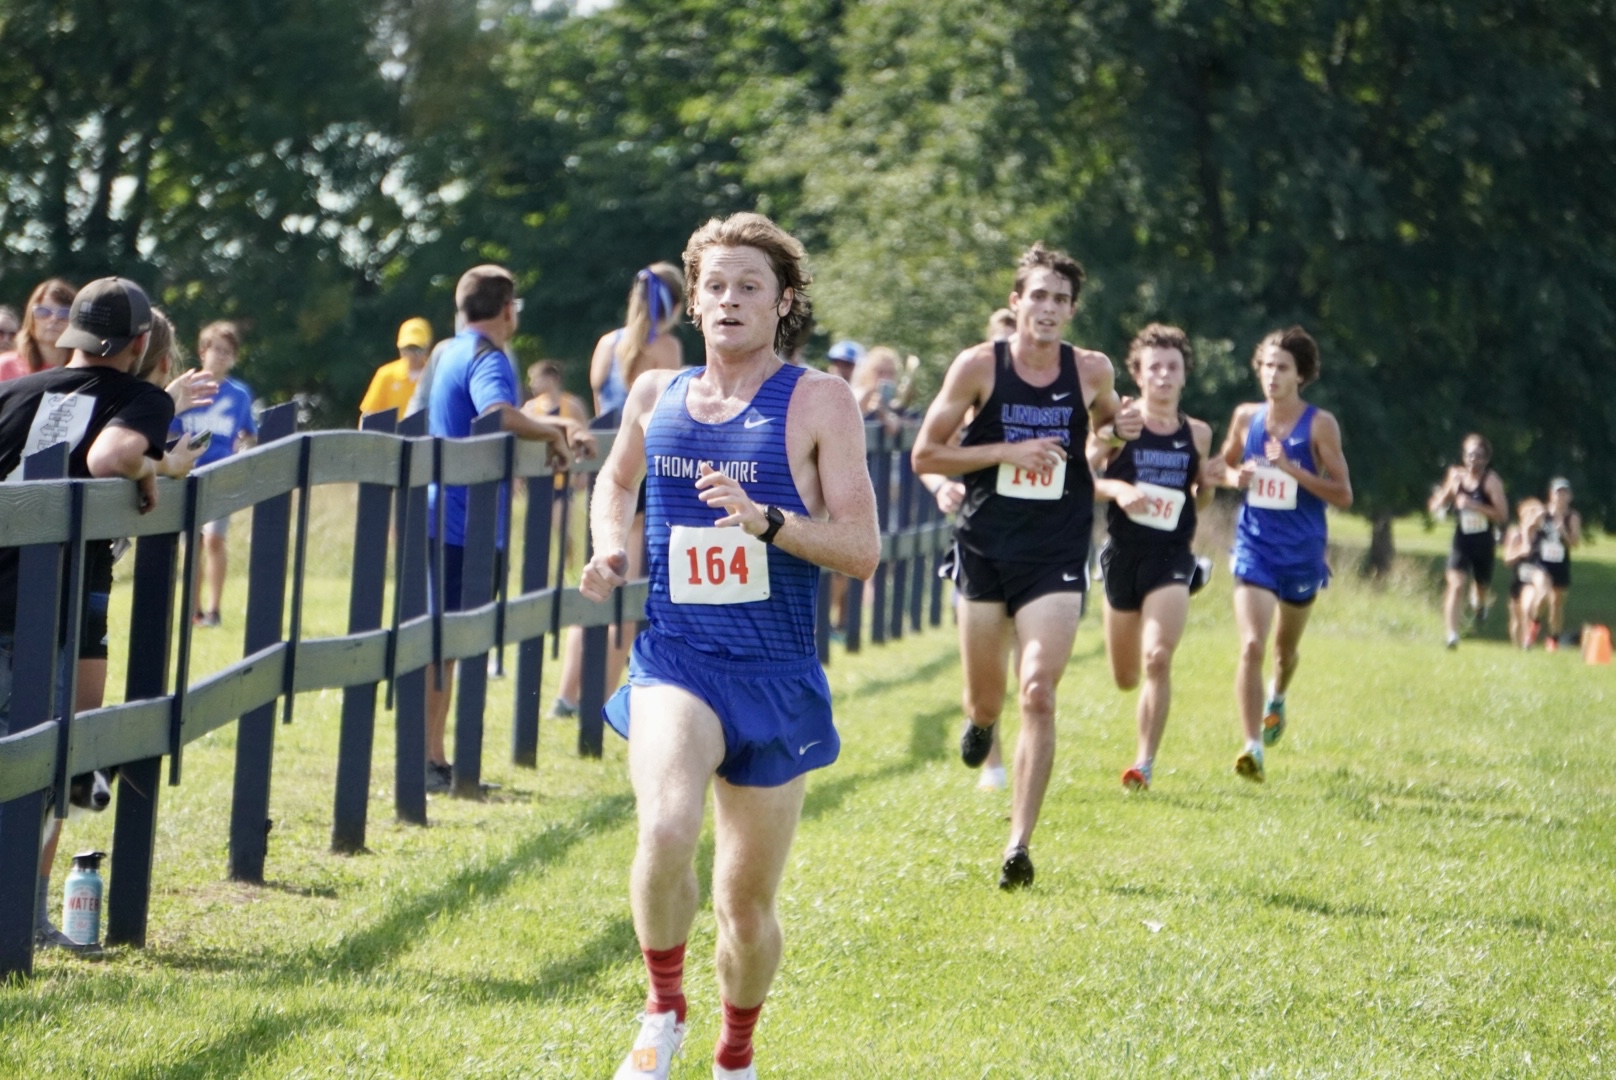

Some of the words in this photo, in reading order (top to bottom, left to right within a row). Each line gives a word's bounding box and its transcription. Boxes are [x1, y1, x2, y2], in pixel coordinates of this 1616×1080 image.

[1001, 403, 1073, 426] LINDSEY
[719, 461, 758, 483] MORE
[1258, 478, 1285, 499] 161
[1152, 497, 1174, 519] 36
[686, 546, 749, 585] 164
[68, 896, 99, 911] WATER
